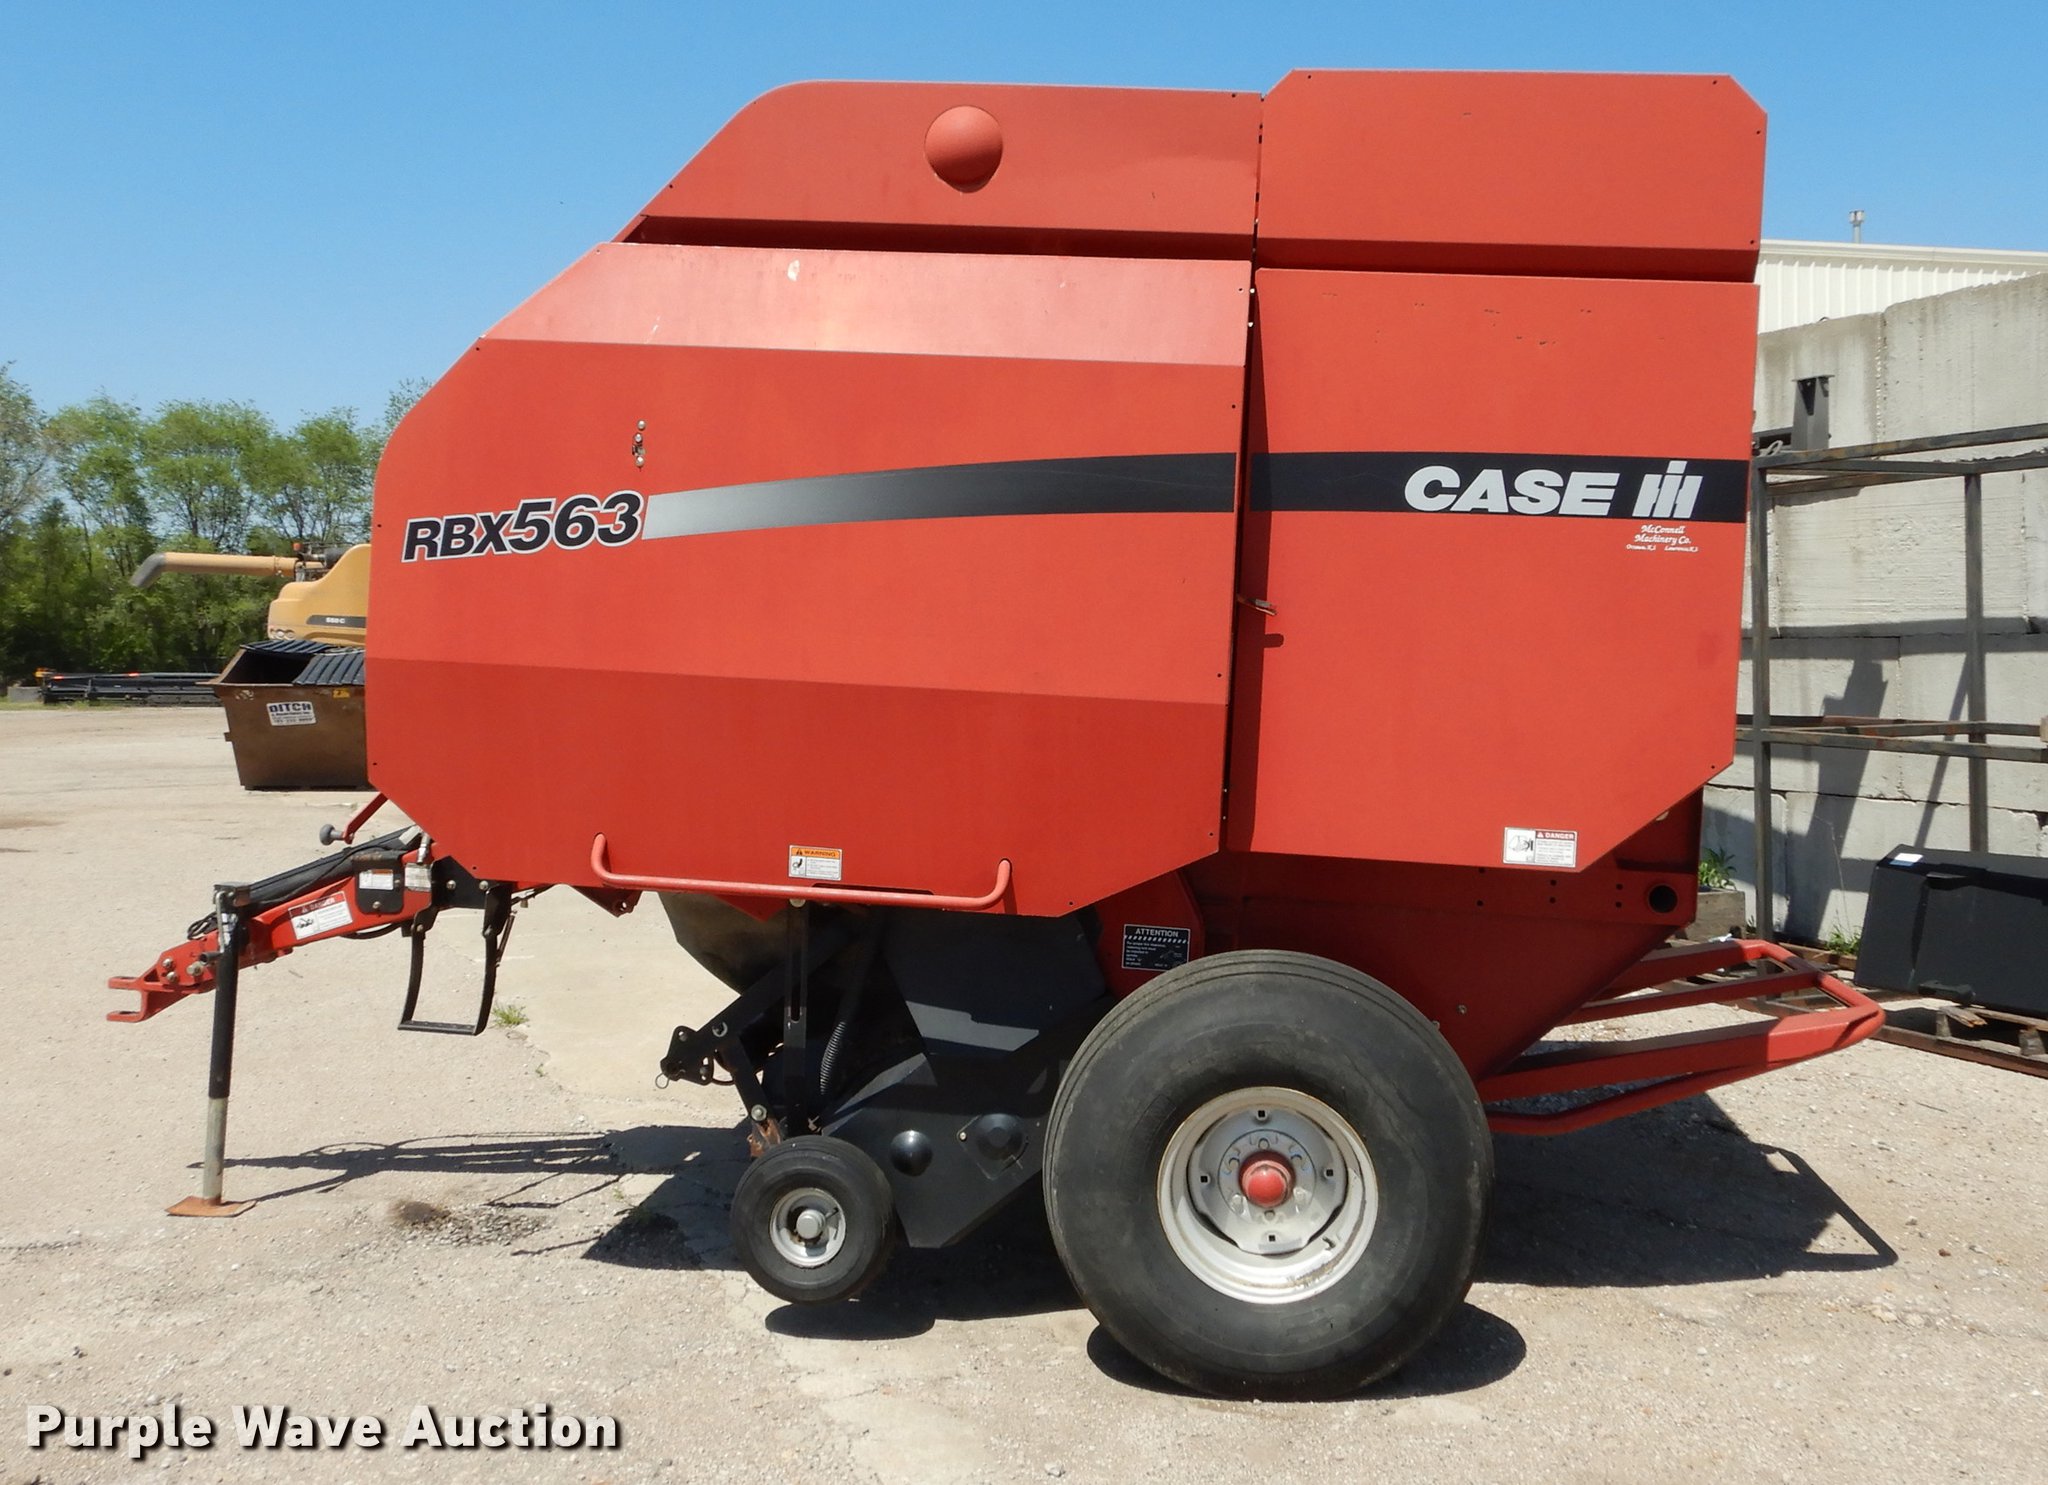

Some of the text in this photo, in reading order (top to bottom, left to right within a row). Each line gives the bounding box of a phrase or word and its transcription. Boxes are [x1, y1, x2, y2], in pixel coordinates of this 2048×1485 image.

[1404, 465, 1620, 516] CASE
[401, 489, 644, 563] RBX563
[1634, 533, 1692, 546] Machinery Co.
[269, 703, 311, 712] DITCH
[1135, 928, 1179, 937] ATTENTION
